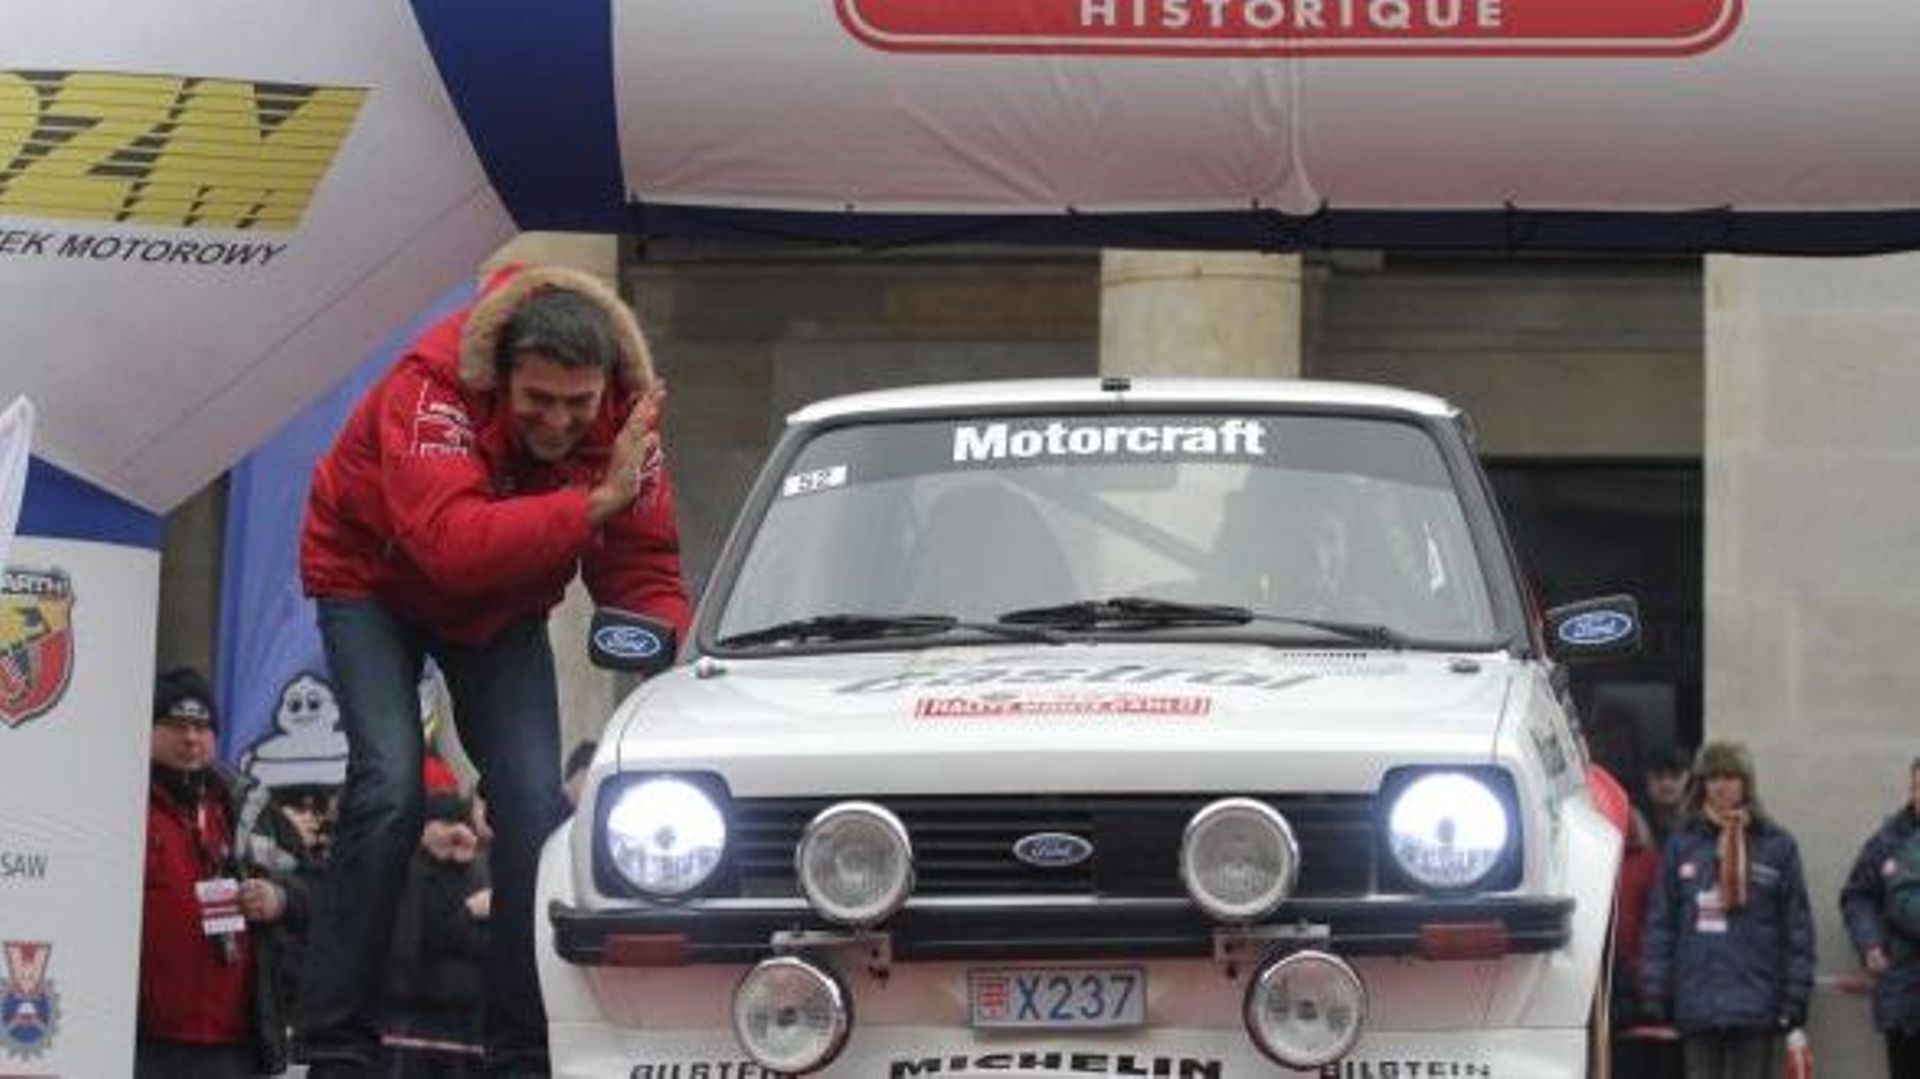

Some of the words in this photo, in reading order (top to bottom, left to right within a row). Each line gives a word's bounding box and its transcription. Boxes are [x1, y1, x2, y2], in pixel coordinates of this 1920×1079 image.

[1079, 0, 1502, 28] HISTORIQUE
[0, 230, 52, 254] EK
[57, 233, 287, 265] MOTOROWY
[953, 419, 1266, 461] Motorcraft
[1016, 975, 1136, 1020] X237
[890, 1052, 1222, 1079] MICHELIN
